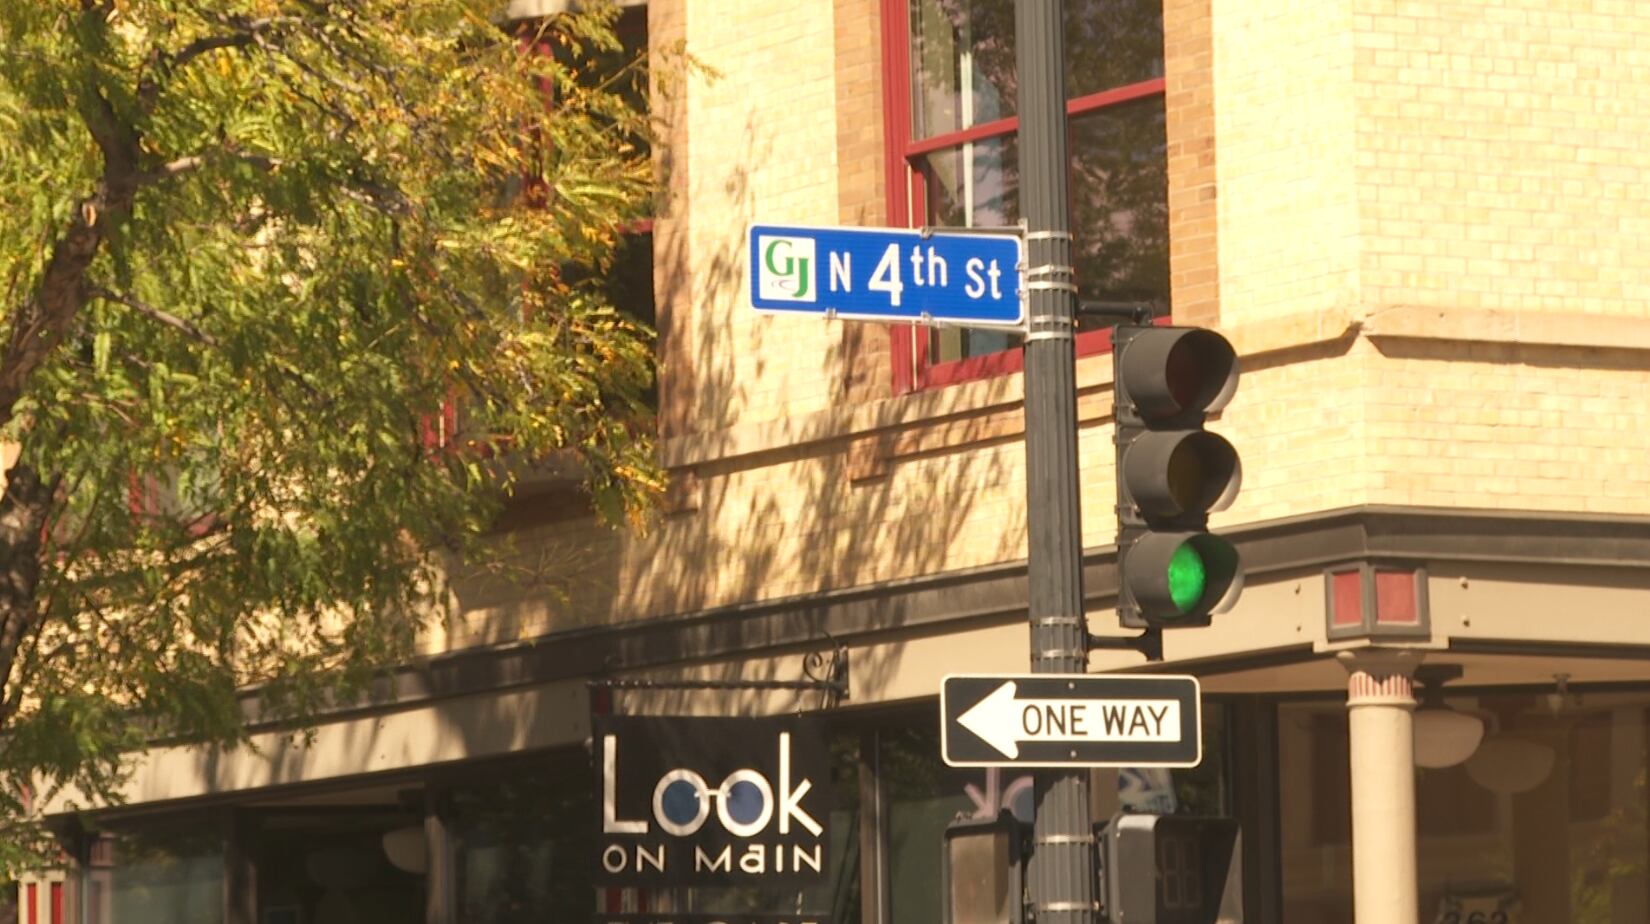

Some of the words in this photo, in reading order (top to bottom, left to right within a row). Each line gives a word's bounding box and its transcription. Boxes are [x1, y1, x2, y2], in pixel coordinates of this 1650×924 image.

[765, 239, 809, 298] GJ
[829, 250, 851, 293] N
[867, 243, 948, 306] 4th
[964, 257, 1002, 300] St
[1022, 704, 1088, 736] ONE
[1102, 705, 1169, 737] WAY
[603, 732, 824, 837] Look
[602, 844, 665, 873] ON
